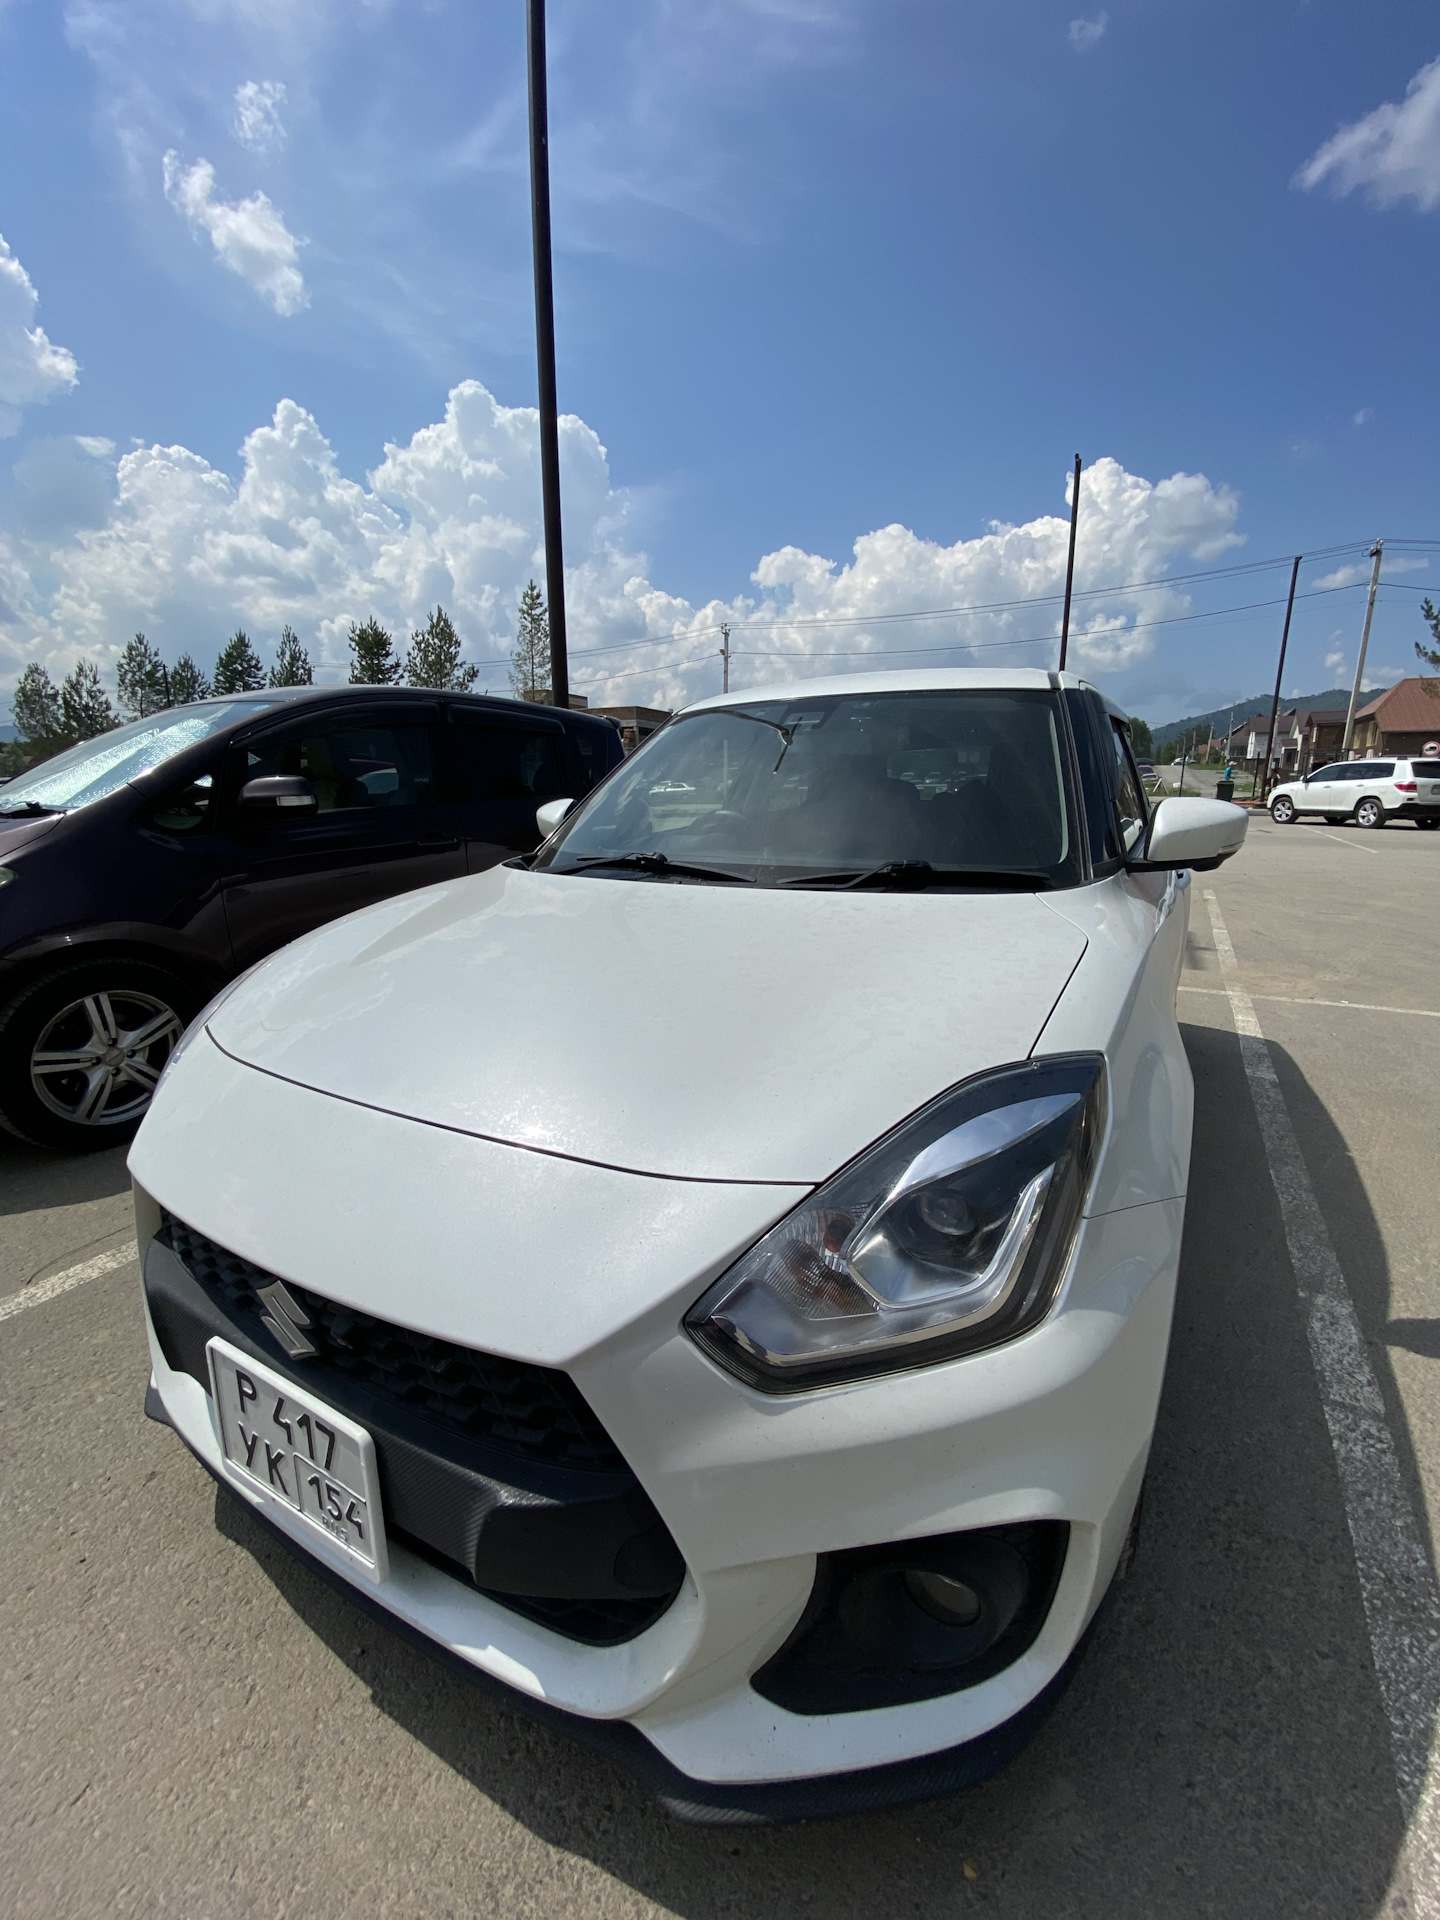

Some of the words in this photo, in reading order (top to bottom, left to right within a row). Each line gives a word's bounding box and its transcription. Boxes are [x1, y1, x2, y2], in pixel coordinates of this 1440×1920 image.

[273, 1397, 336, 1471] 417
[307, 1472, 364, 1539] 154
[321, 1513, 349, 1541] RUS
